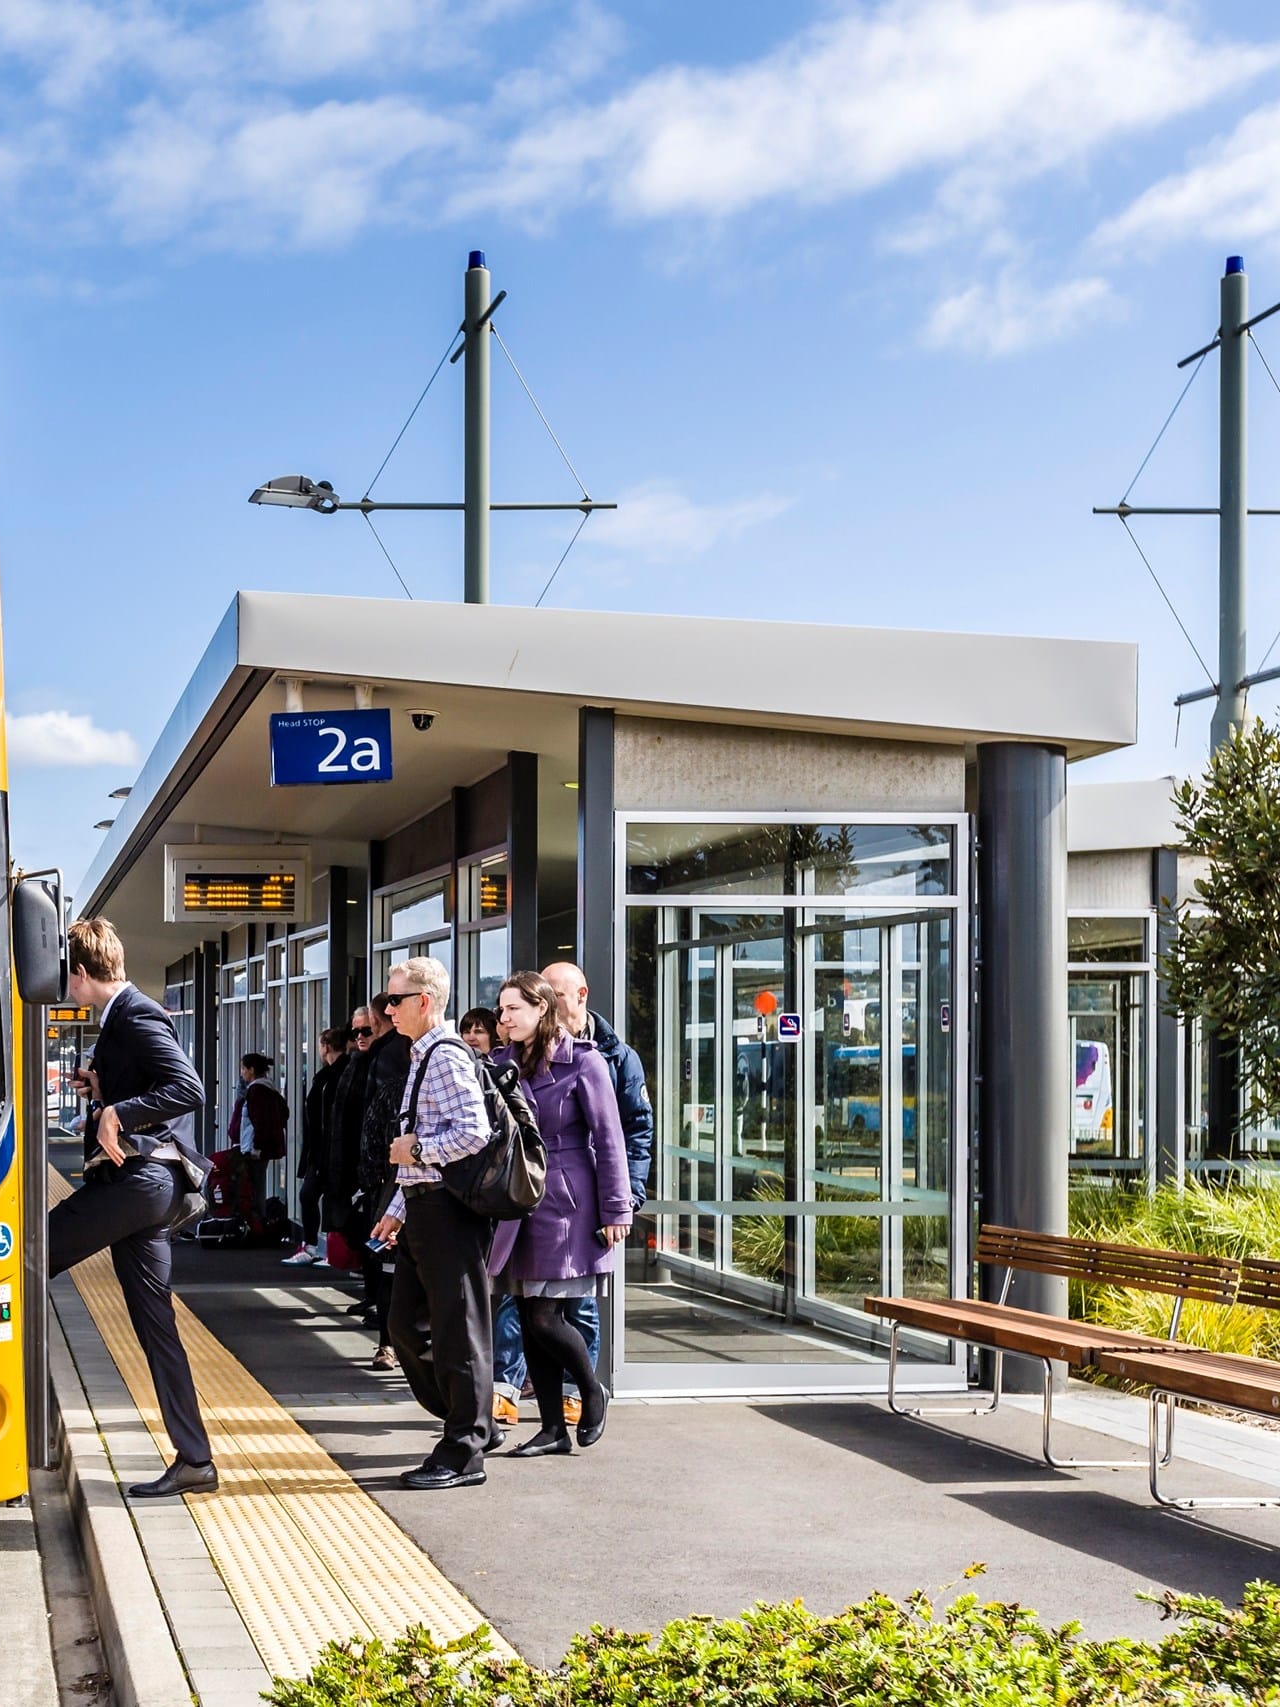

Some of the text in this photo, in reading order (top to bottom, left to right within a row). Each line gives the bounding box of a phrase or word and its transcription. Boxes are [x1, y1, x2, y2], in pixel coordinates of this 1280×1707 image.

[278, 718, 326, 728] Head STOP
[318, 727, 381, 773] 2a
